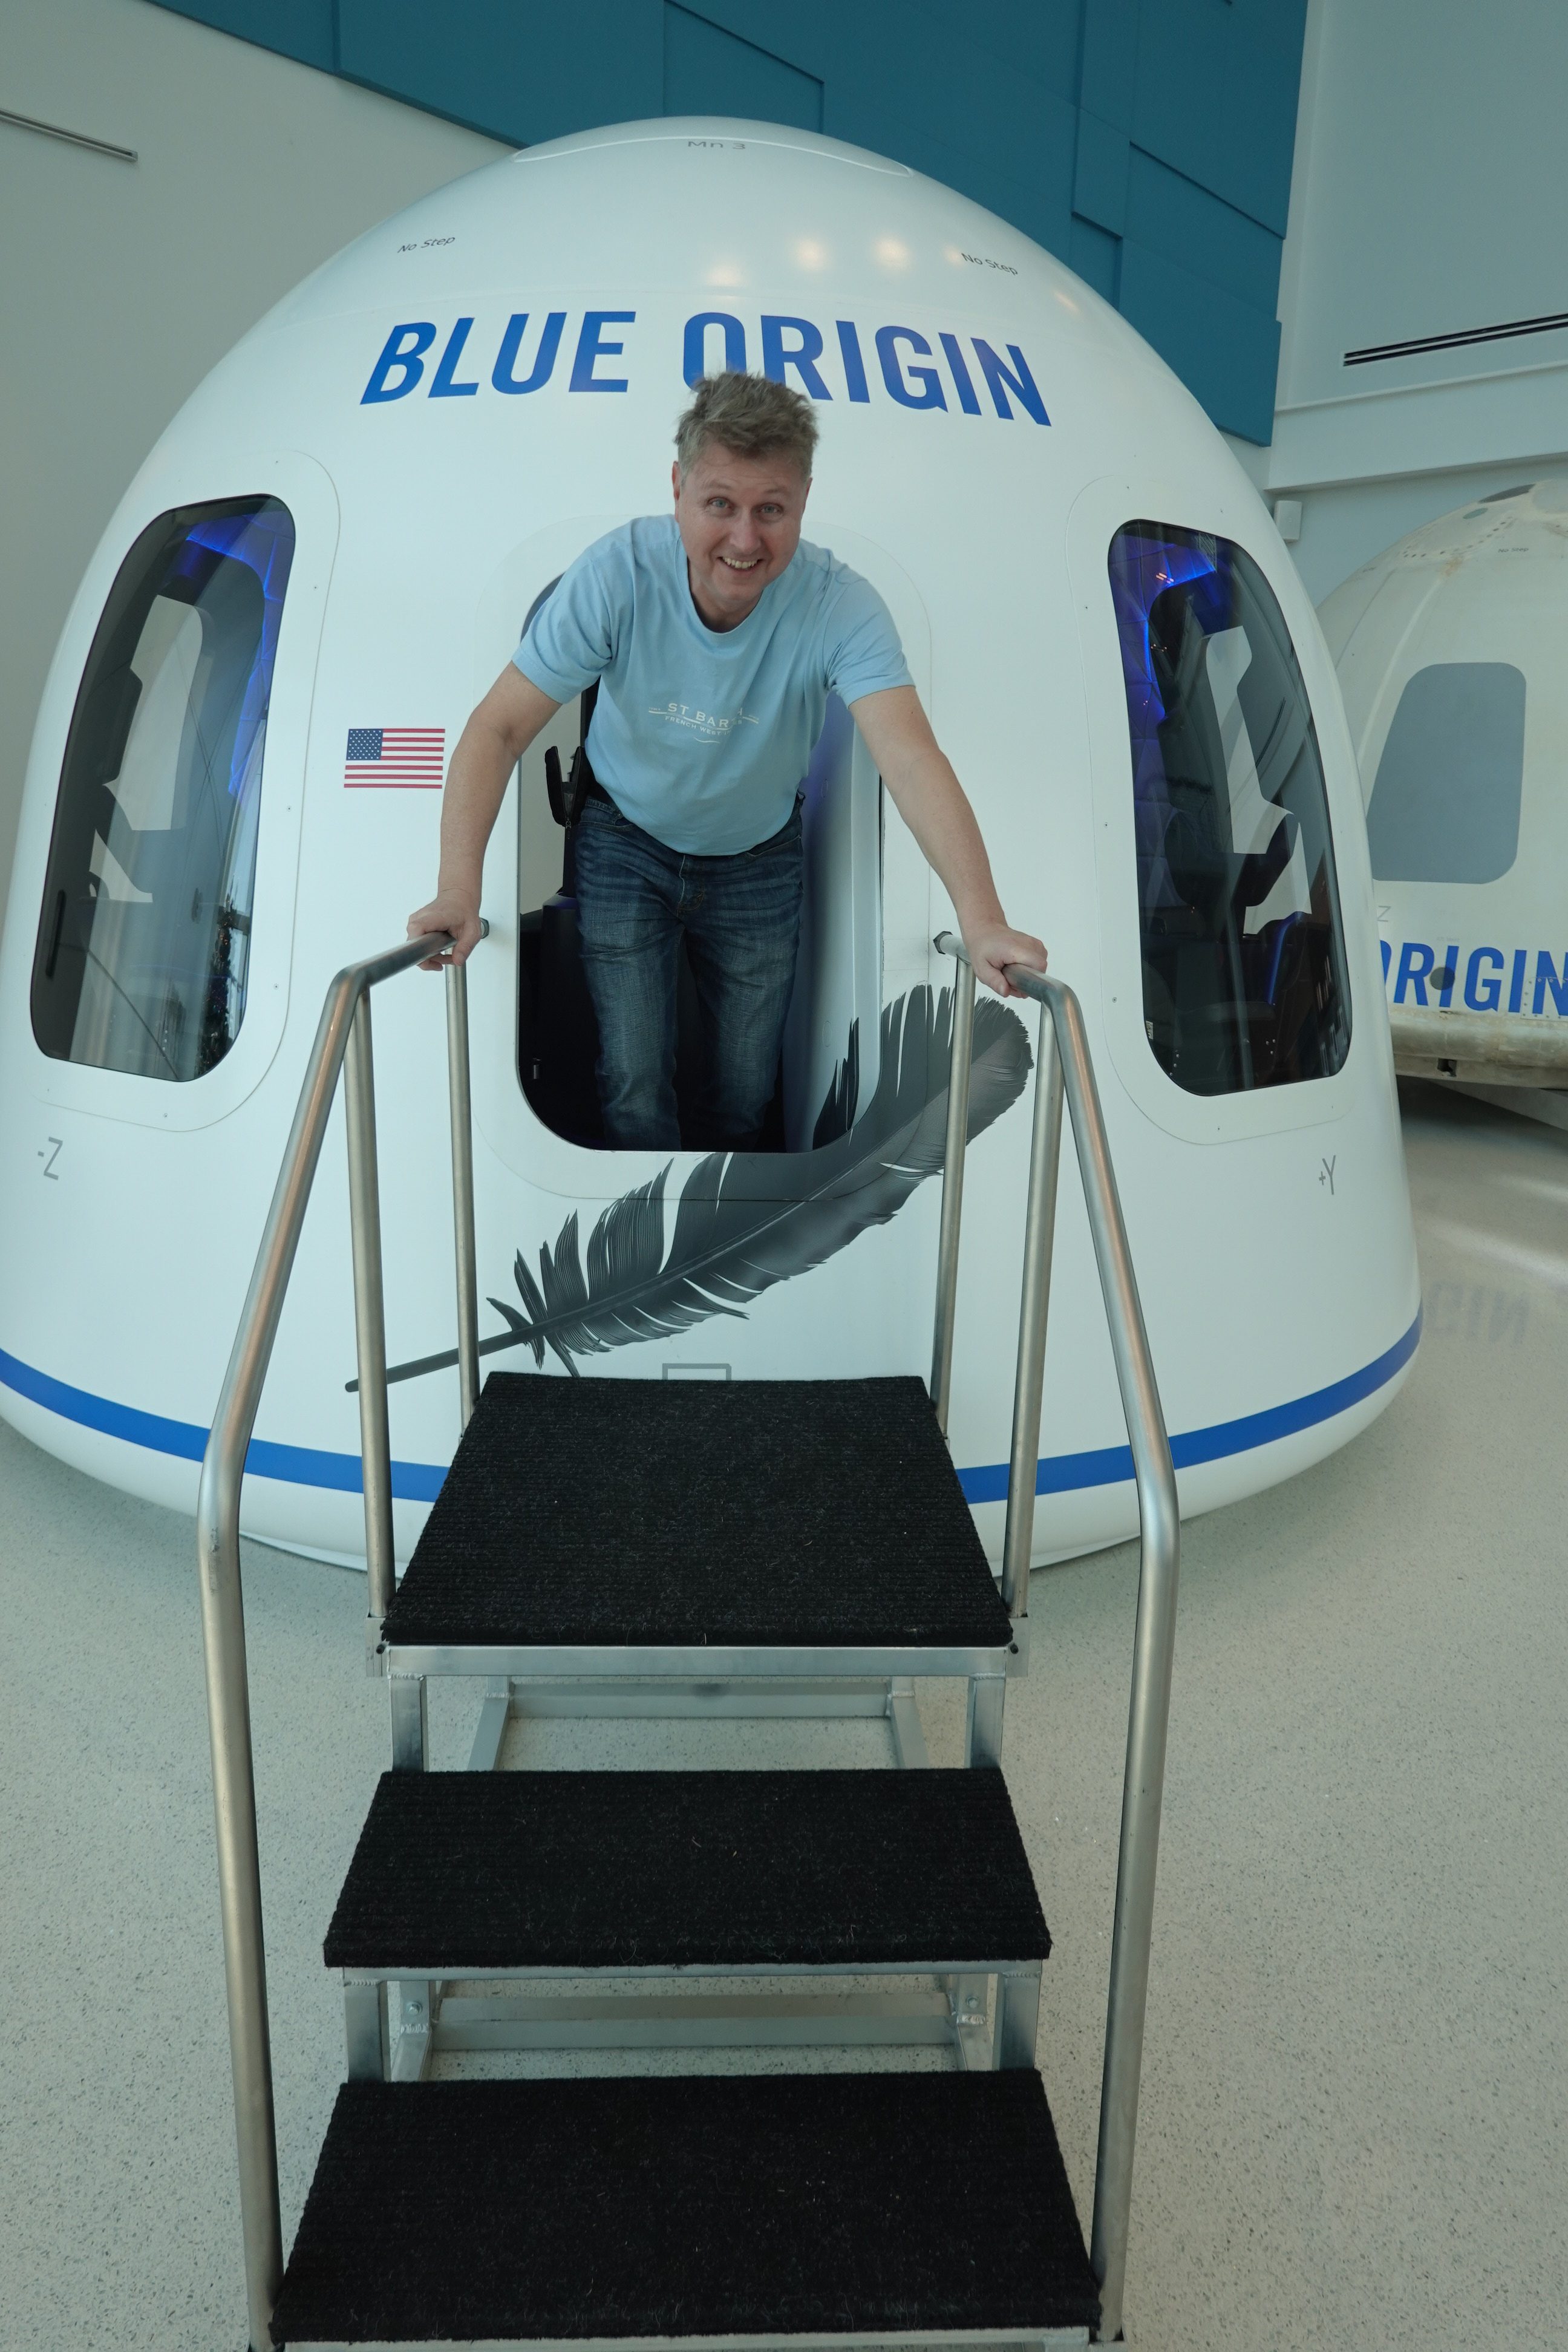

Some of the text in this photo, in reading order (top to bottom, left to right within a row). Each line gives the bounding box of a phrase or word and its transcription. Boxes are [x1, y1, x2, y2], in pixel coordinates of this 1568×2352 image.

[397, 237, 456, 253] No Step
[961, 253, 1018, 276] No Step
[360, 312, 1051, 426] BLUE ORIGIN
[668, 703, 689, 715] ST
[665, 716, 697, 730] FRENCH
